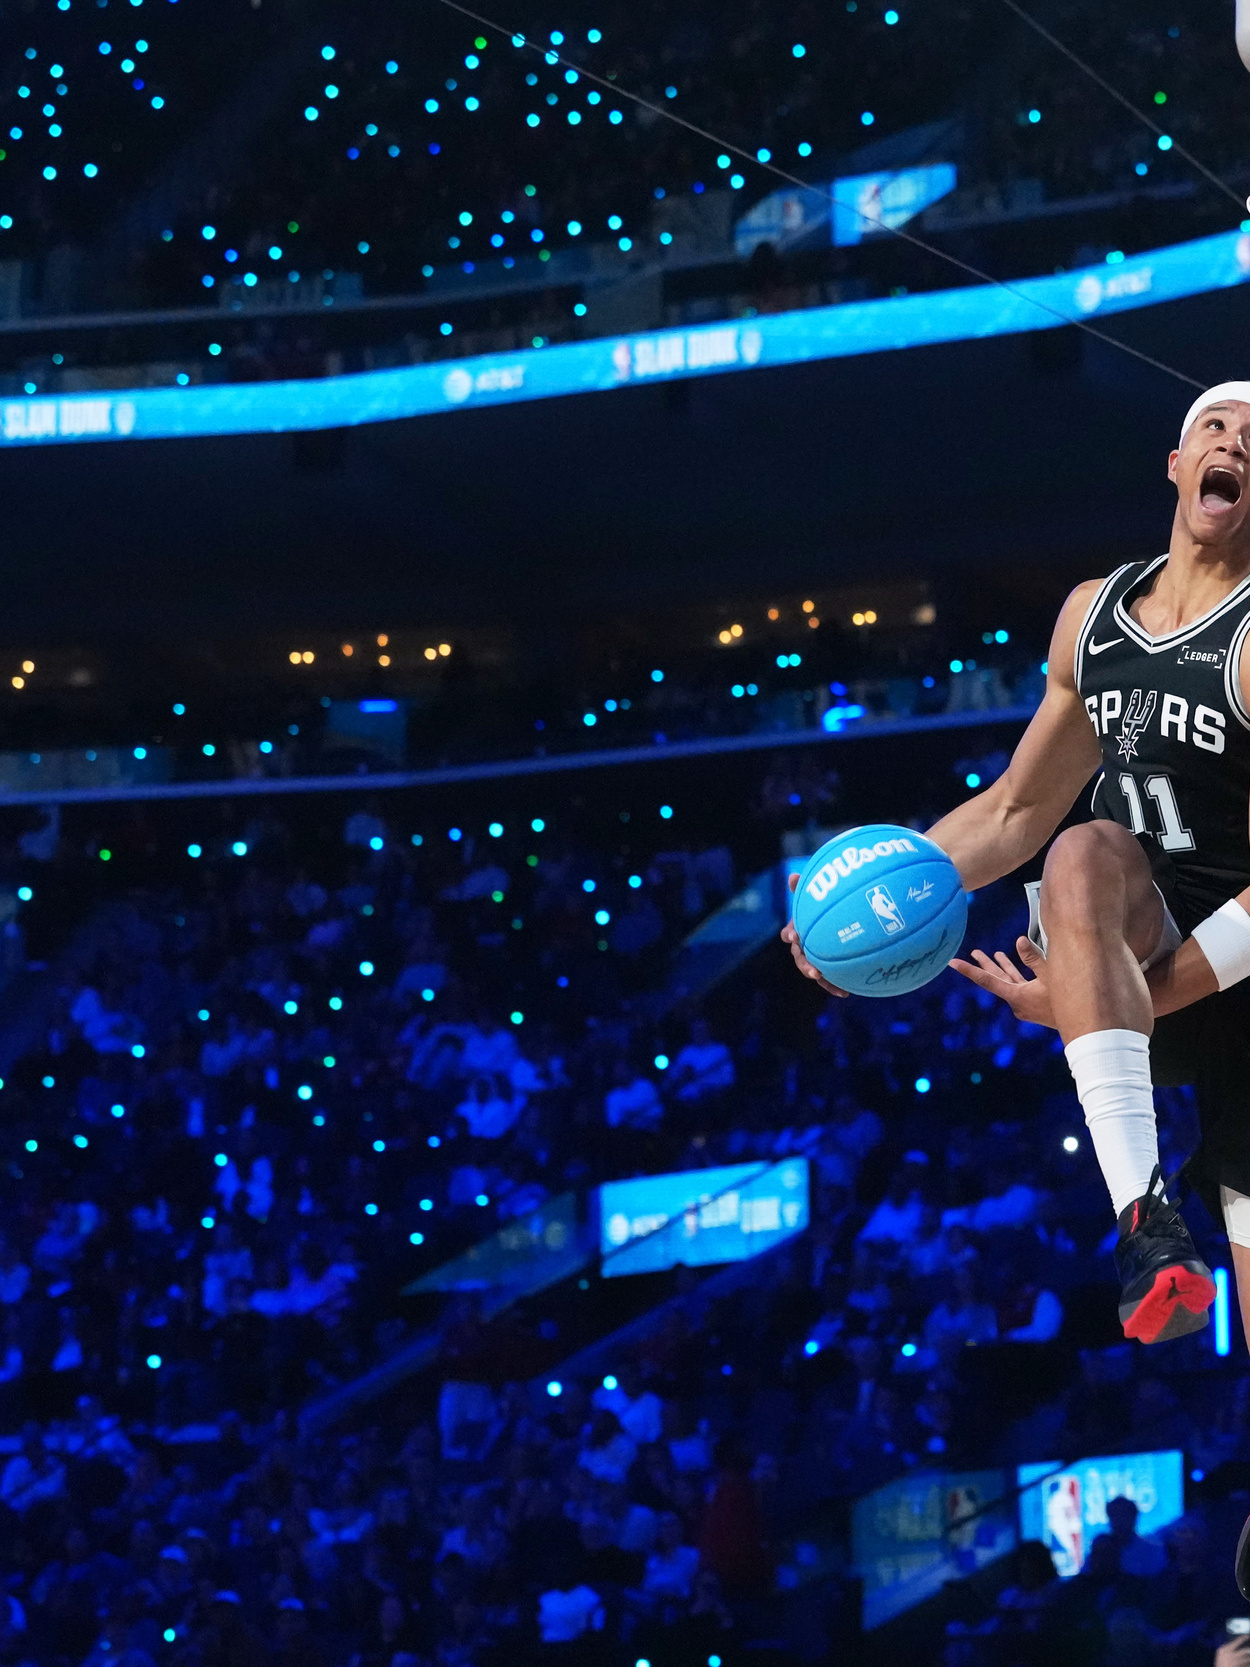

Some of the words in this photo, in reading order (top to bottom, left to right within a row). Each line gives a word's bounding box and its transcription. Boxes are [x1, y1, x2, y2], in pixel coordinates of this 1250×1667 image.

[1184, 650, 1219, 664] LEDGER
[1085, 689, 1226, 763] SPURS
[1118, 773, 1196, 853] 11
[806, 838, 918, 902] Wilson
